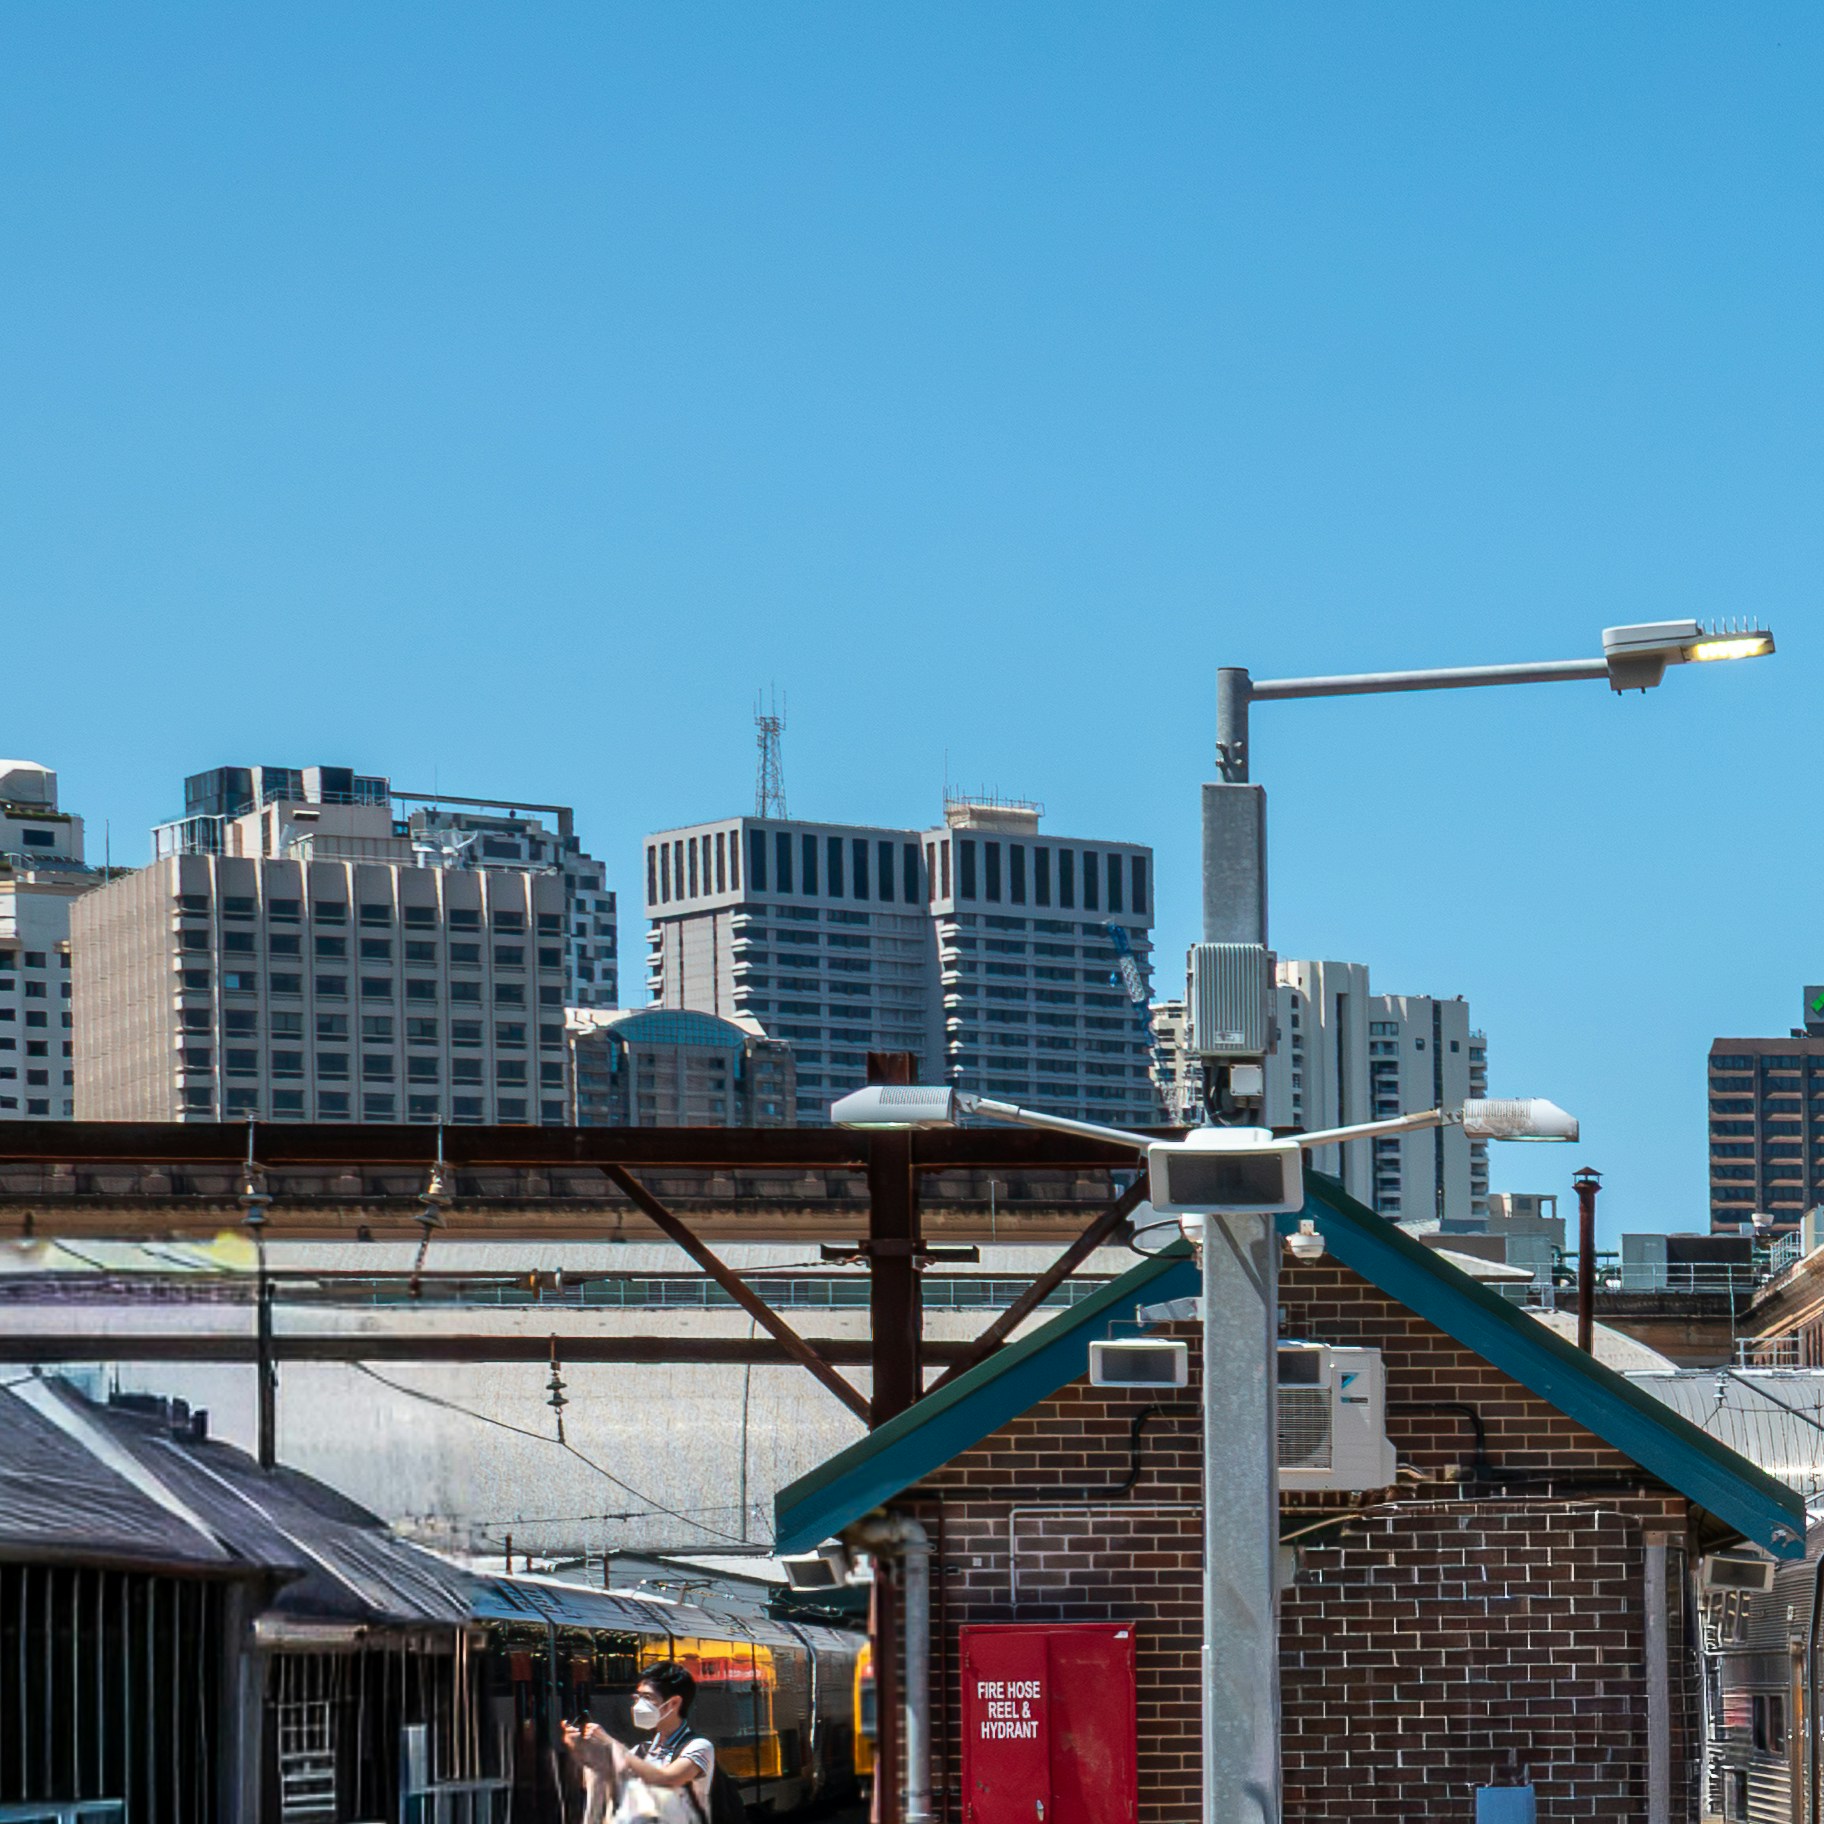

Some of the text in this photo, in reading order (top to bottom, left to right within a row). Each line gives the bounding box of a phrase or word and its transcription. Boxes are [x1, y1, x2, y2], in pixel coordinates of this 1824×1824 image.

[977, 1681, 1041, 1699] FIRE HOSE
[988, 1701, 1032, 1719] REEL &
[981, 1721, 1039, 1739] HYDRANT
